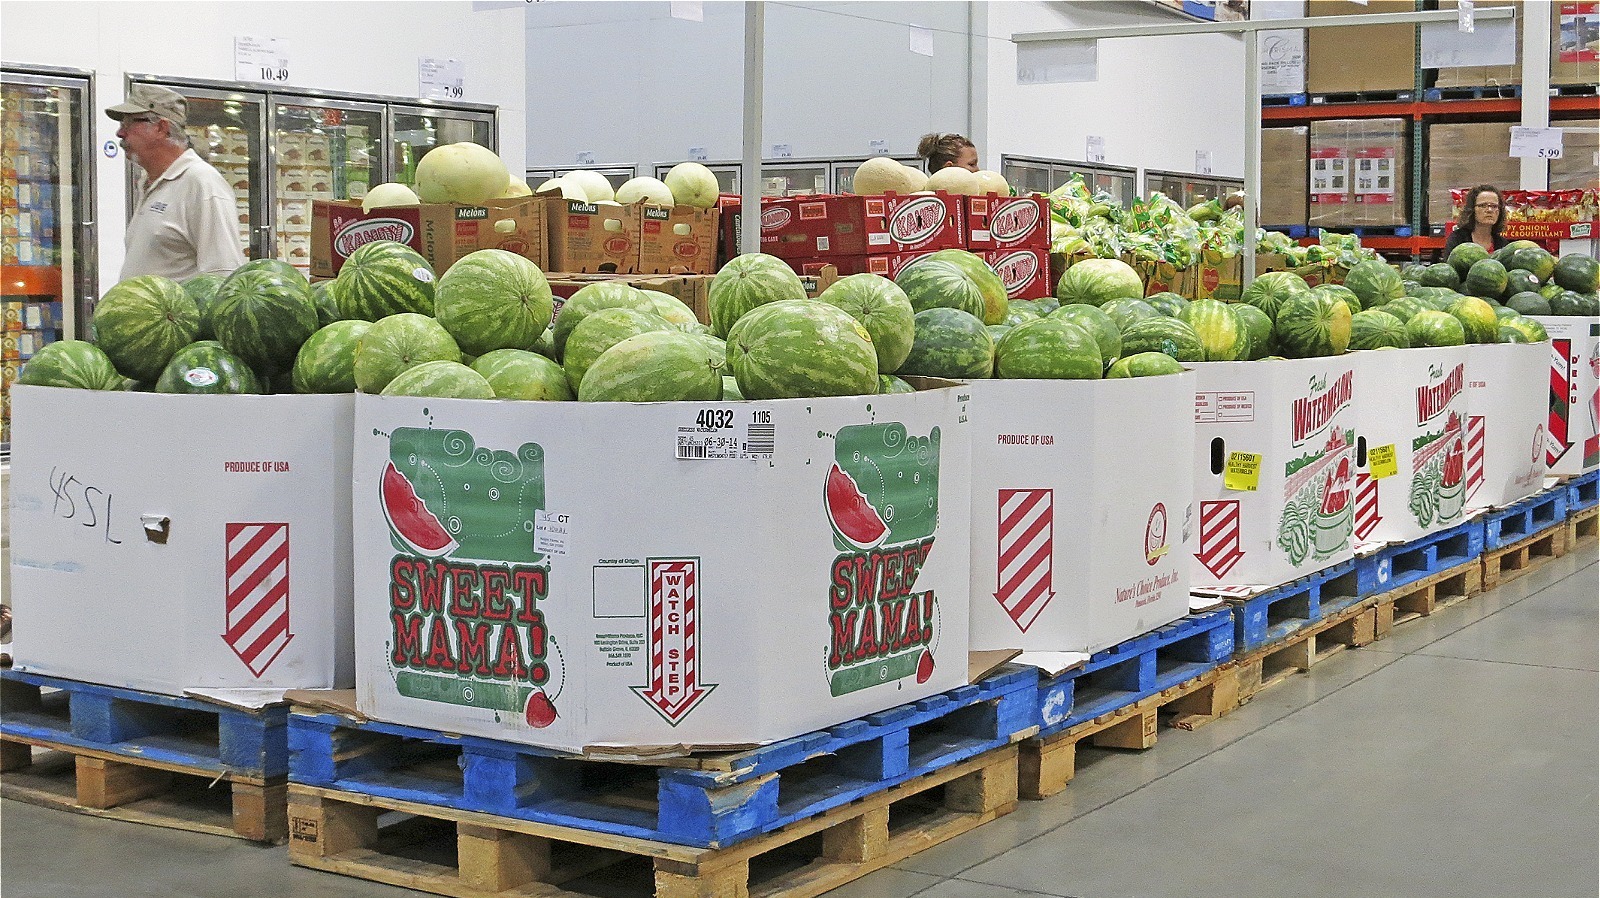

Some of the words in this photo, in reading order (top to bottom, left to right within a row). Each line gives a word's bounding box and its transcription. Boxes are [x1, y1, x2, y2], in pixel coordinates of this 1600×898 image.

[261, 67, 289, 81] 10.49
[444, 86, 463, 99] 7.99
[1538, 148, 1560, 158] 5.99
[458, 207, 486, 217] Melons
[571, 203, 596, 212] Melons
[646, 209, 668, 218] Melons
[342, 223, 403, 255] KANDY
[1428, 362, 1442, 382] Fresh
[1309, 372, 1327, 397] Fresh
[1417, 363, 1464, 424] WATERMELONS
[1293, 370, 1353, 441] WATERMELONS
[696, 410, 734, 428] 4032
[752, 411, 770, 423] 1105
[704, 437, 738, 446] 06-30-14
[998, 434, 1029, 445] PRODUCE
[1030, 435, 1040, 445] OF
[1040, 435, 1054, 446] USA
[224, 462, 260, 473] PRODUCE
[262, 462, 272, 472] OF
[274, 462, 290, 473] USA
[558, 514, 570, 523] CT
[830, 536, 935, 609] SWEE
[390, 555, 550, 623] SWEET
[1136, 578, 1153, 596] Choice
[666, 575, 682, 635] WATCH
[829, 590, 934, 669] MAMA!
[390, 610, 550, 685] MAMA!
[668, 649, 680, 696] STEP
